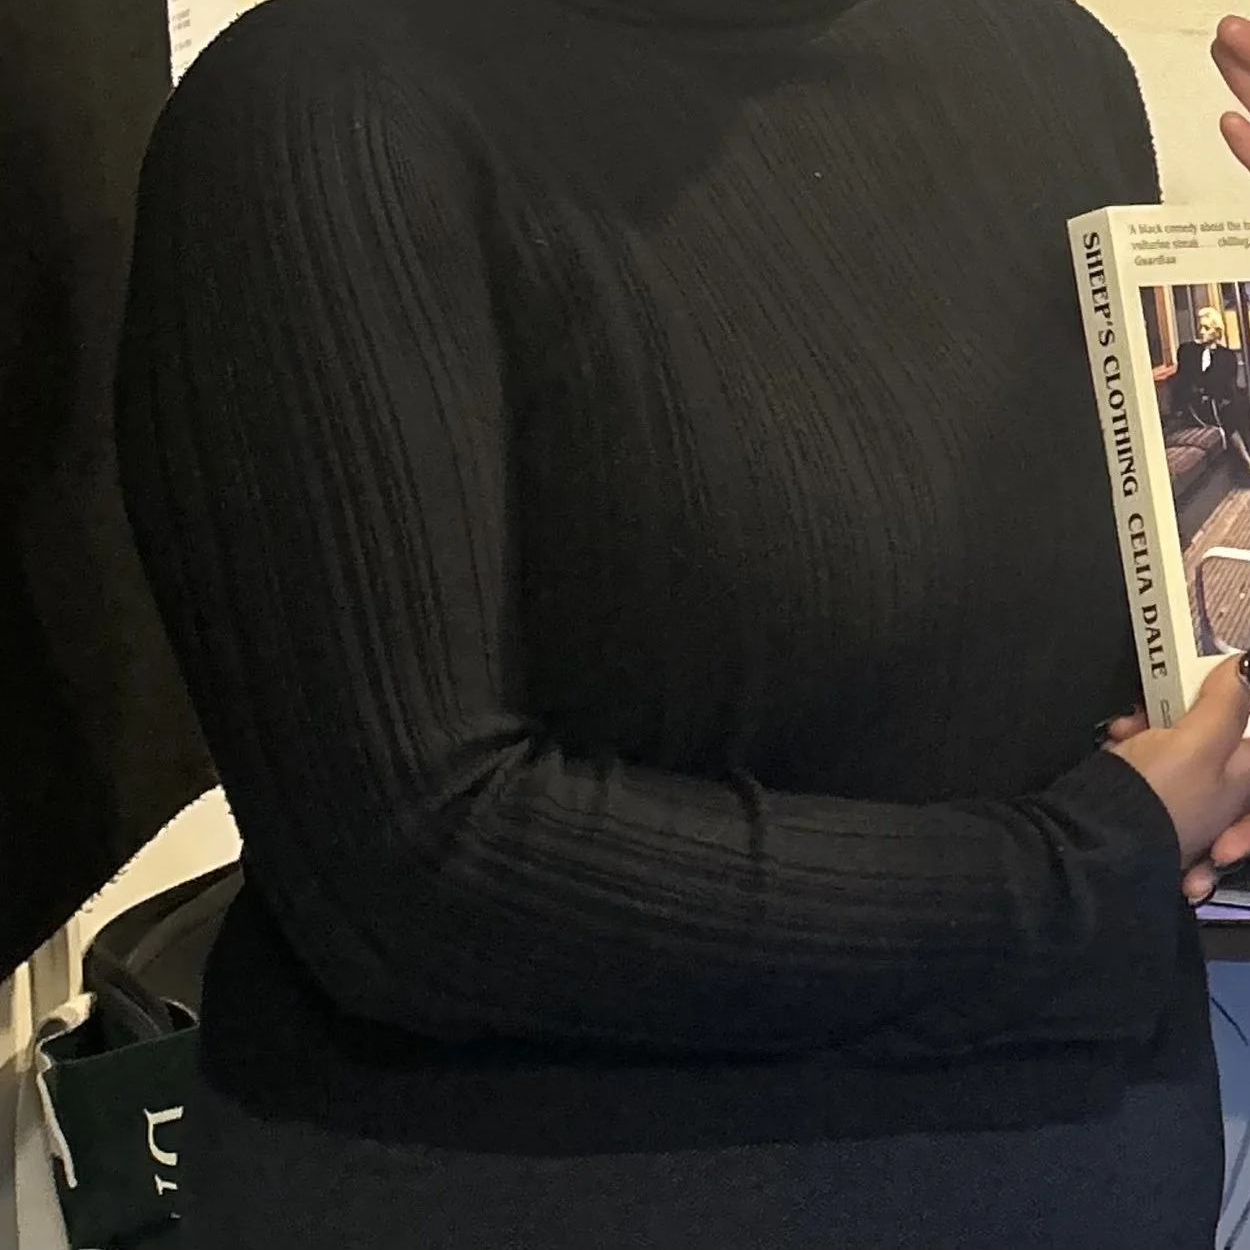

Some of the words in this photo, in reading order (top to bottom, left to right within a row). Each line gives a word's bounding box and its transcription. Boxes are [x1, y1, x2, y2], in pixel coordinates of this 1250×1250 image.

[1138, 222, 1163, 234] black
[1164, 222, 1197, 235] comedy
[1200, 221, 1225, 232] about
[1226, 220, 1241, 231] the
[1134, 255, 1177, 266] Guardian
[1082, 231, 1115, 348] SHEEP'S
[1101, 354, 1140, 499] CLOTHING
[1126, 512, 1153, 595] CELIA
[1142, 603, 1168, 680] DALE
